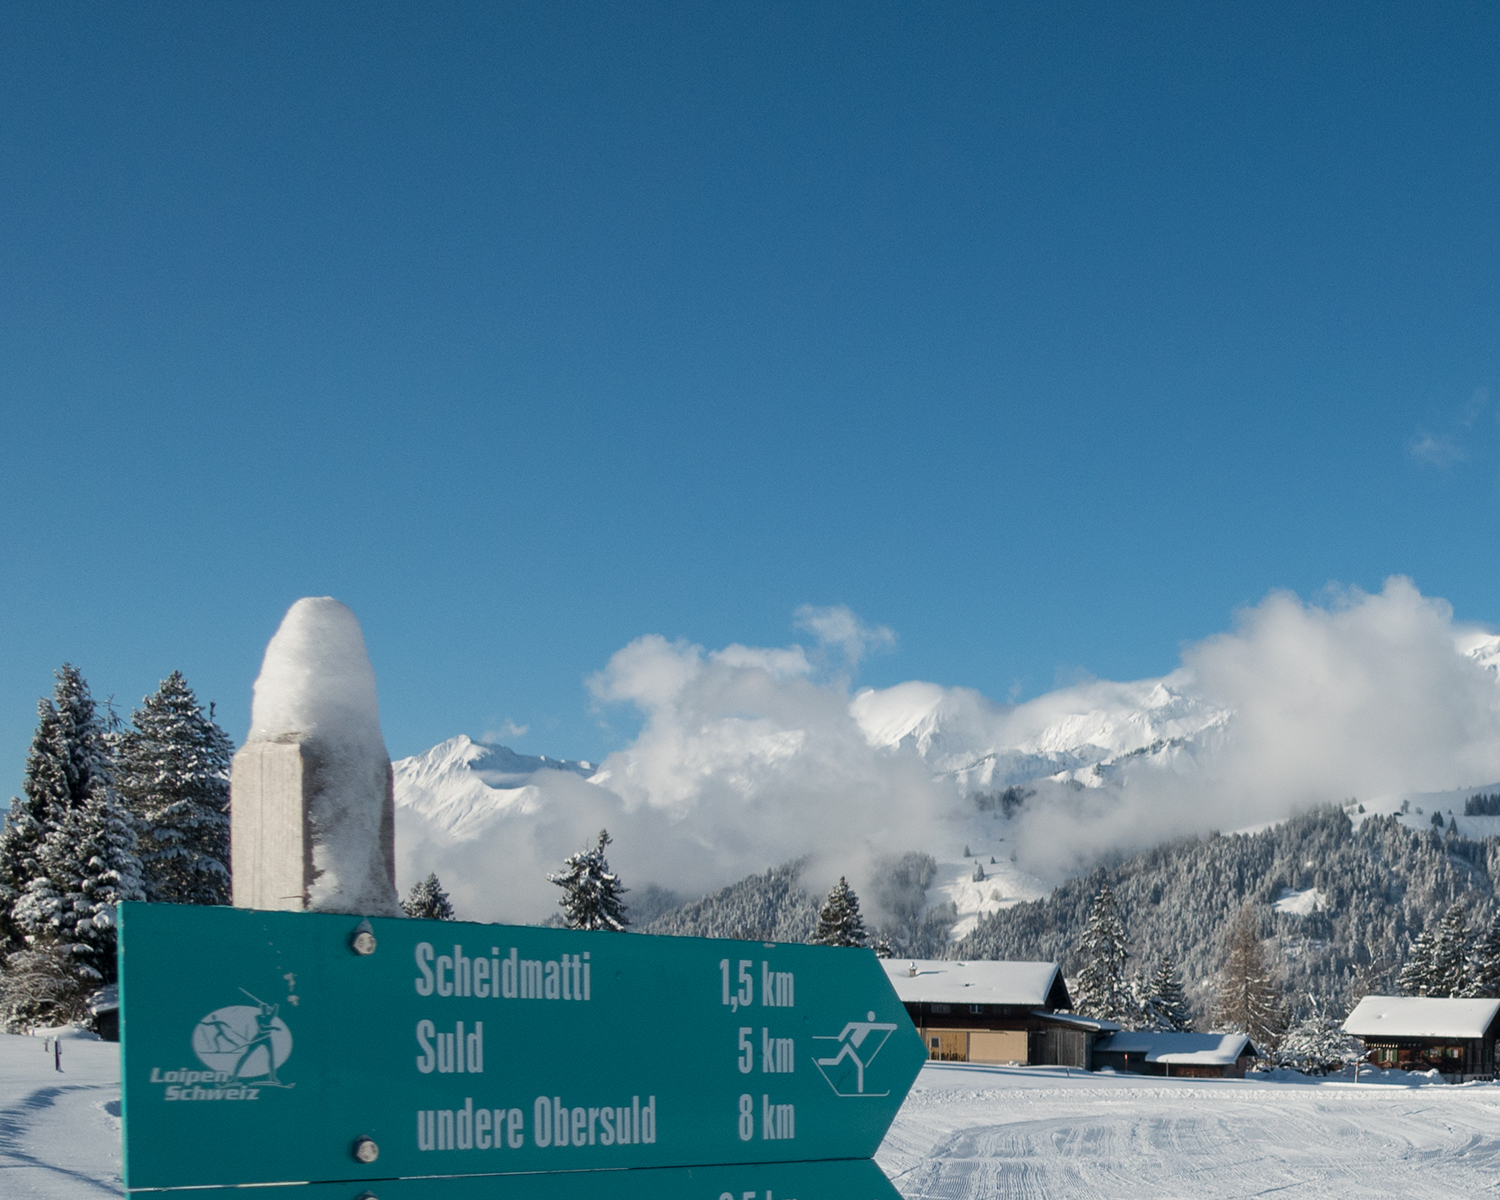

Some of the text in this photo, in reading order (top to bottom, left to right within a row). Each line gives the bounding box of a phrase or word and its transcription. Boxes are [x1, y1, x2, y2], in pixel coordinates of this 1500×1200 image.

[414, 941, 794, 1013] Scheidmatti 1,5 km
[415, 1019, 794, 1074] Suld 5 km
[150, 1067, 229, 1086] Loipen
[164, 1084, 260, 1101] Schweiz
[416, 1094, 795, 1152] undere Obersuld 8 km
